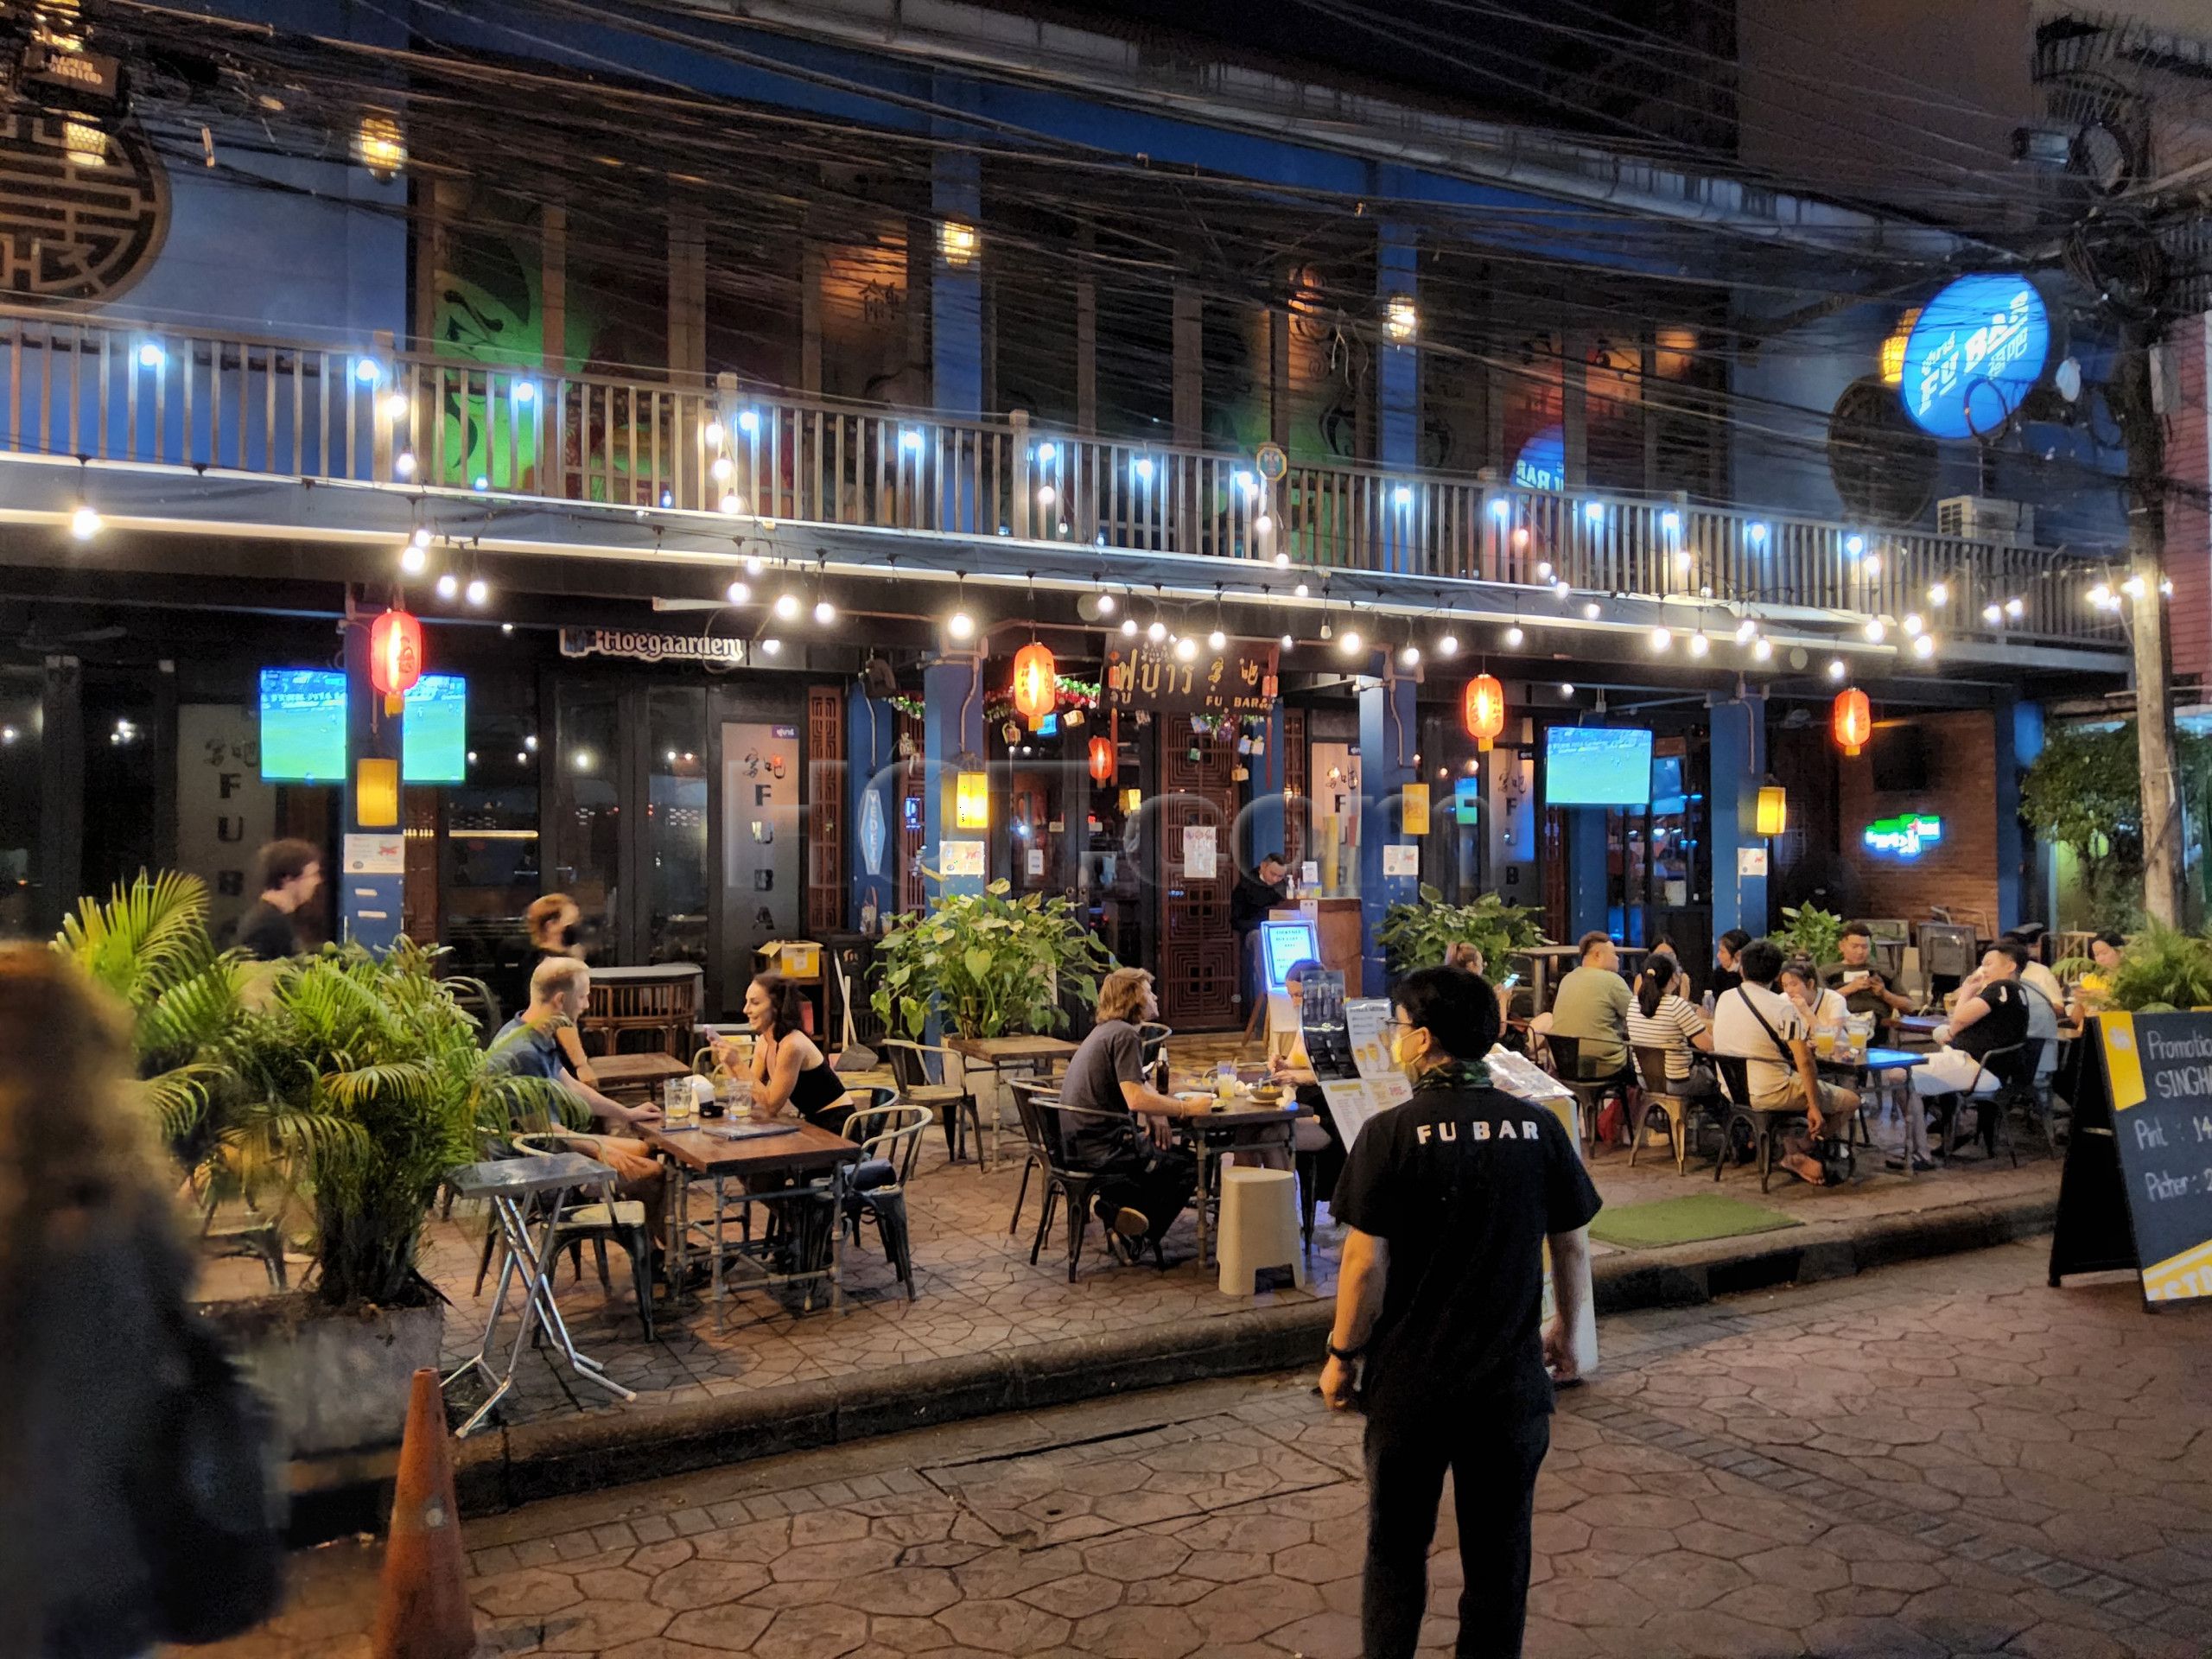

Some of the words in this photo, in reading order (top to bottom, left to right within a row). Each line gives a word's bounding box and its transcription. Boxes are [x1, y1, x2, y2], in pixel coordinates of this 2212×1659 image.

[1919, 350, 1959, 416] FU
[1963, 290, 2029, 374] BAR
[599, 631, 743, 658] Hoegaarden
[1416, 1121, 1457, 1145] FU
[1471, 1119, 1540, 1141] BAR
